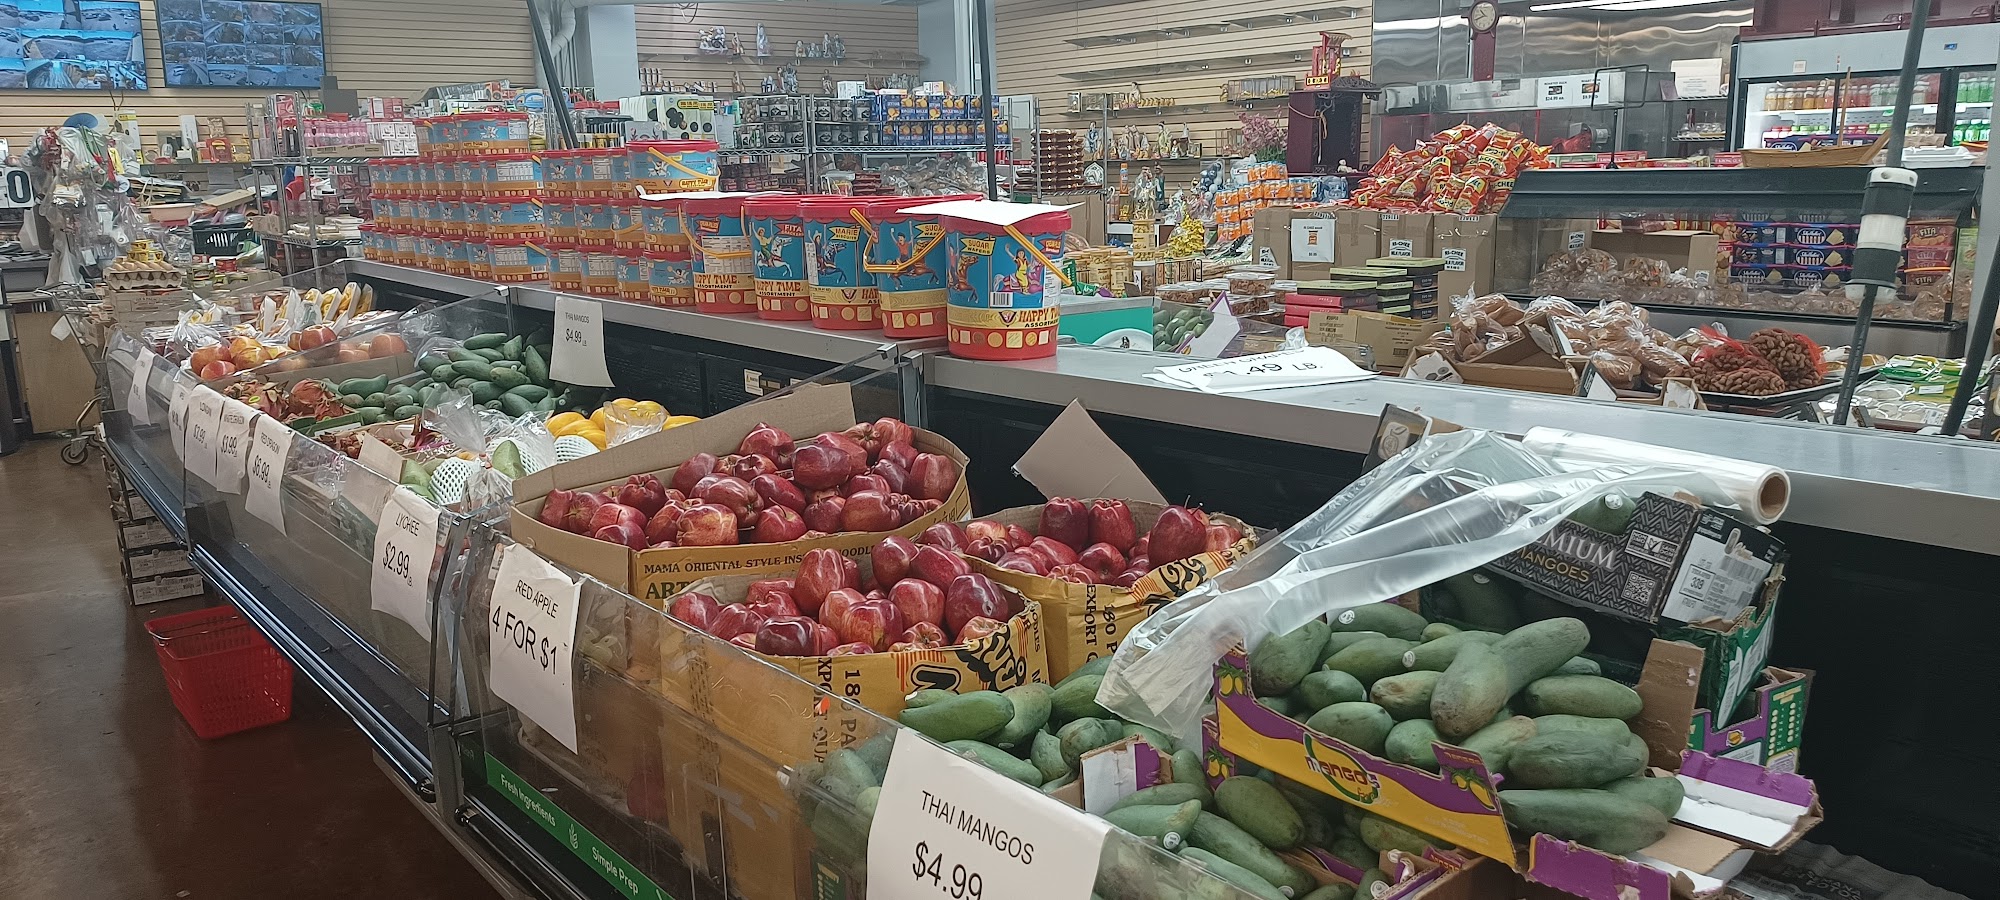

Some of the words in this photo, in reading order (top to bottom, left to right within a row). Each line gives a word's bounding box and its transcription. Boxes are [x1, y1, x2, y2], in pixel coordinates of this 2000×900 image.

[835, 227, 858, 236] MARIE
[968, 240, 990, 249] SUGAR
[1919, 227, 1936, 237] FITA
[1018, 308, 1048, 323] HAPPY
[395, 512, 420, 537] LYCHEE
[382, 541, 410, 579] $2.99
[644, 562, 680, 574] MAMA
[685, 560, 742, 572] ORIENTAL
[746, 556, 785, 568] STYLE
[1536, 530, 1616, 570] MIUM
[515, 579, 534, 601] RED
[532, 590, 559, 619] APPLE
[1084, 584, 1098, 646] EXPORT
[1103, 604, 1117, 636] 180
[492, 605, 501, 633] 4
[503, 611, 536, 661] FOR
[540, 636, 557, 675] $1
[500, 773, 519, 798] Fresh
[518, 790, 556, 827] Ingredients
[920, 789, 956, 825] THAI
[957, 809, 1035, 866] MANGOS
[591, 846, 618, 878] Simple
[617, 867, 639, 896] Prep
[912, 840, 984, 900] $4.99
